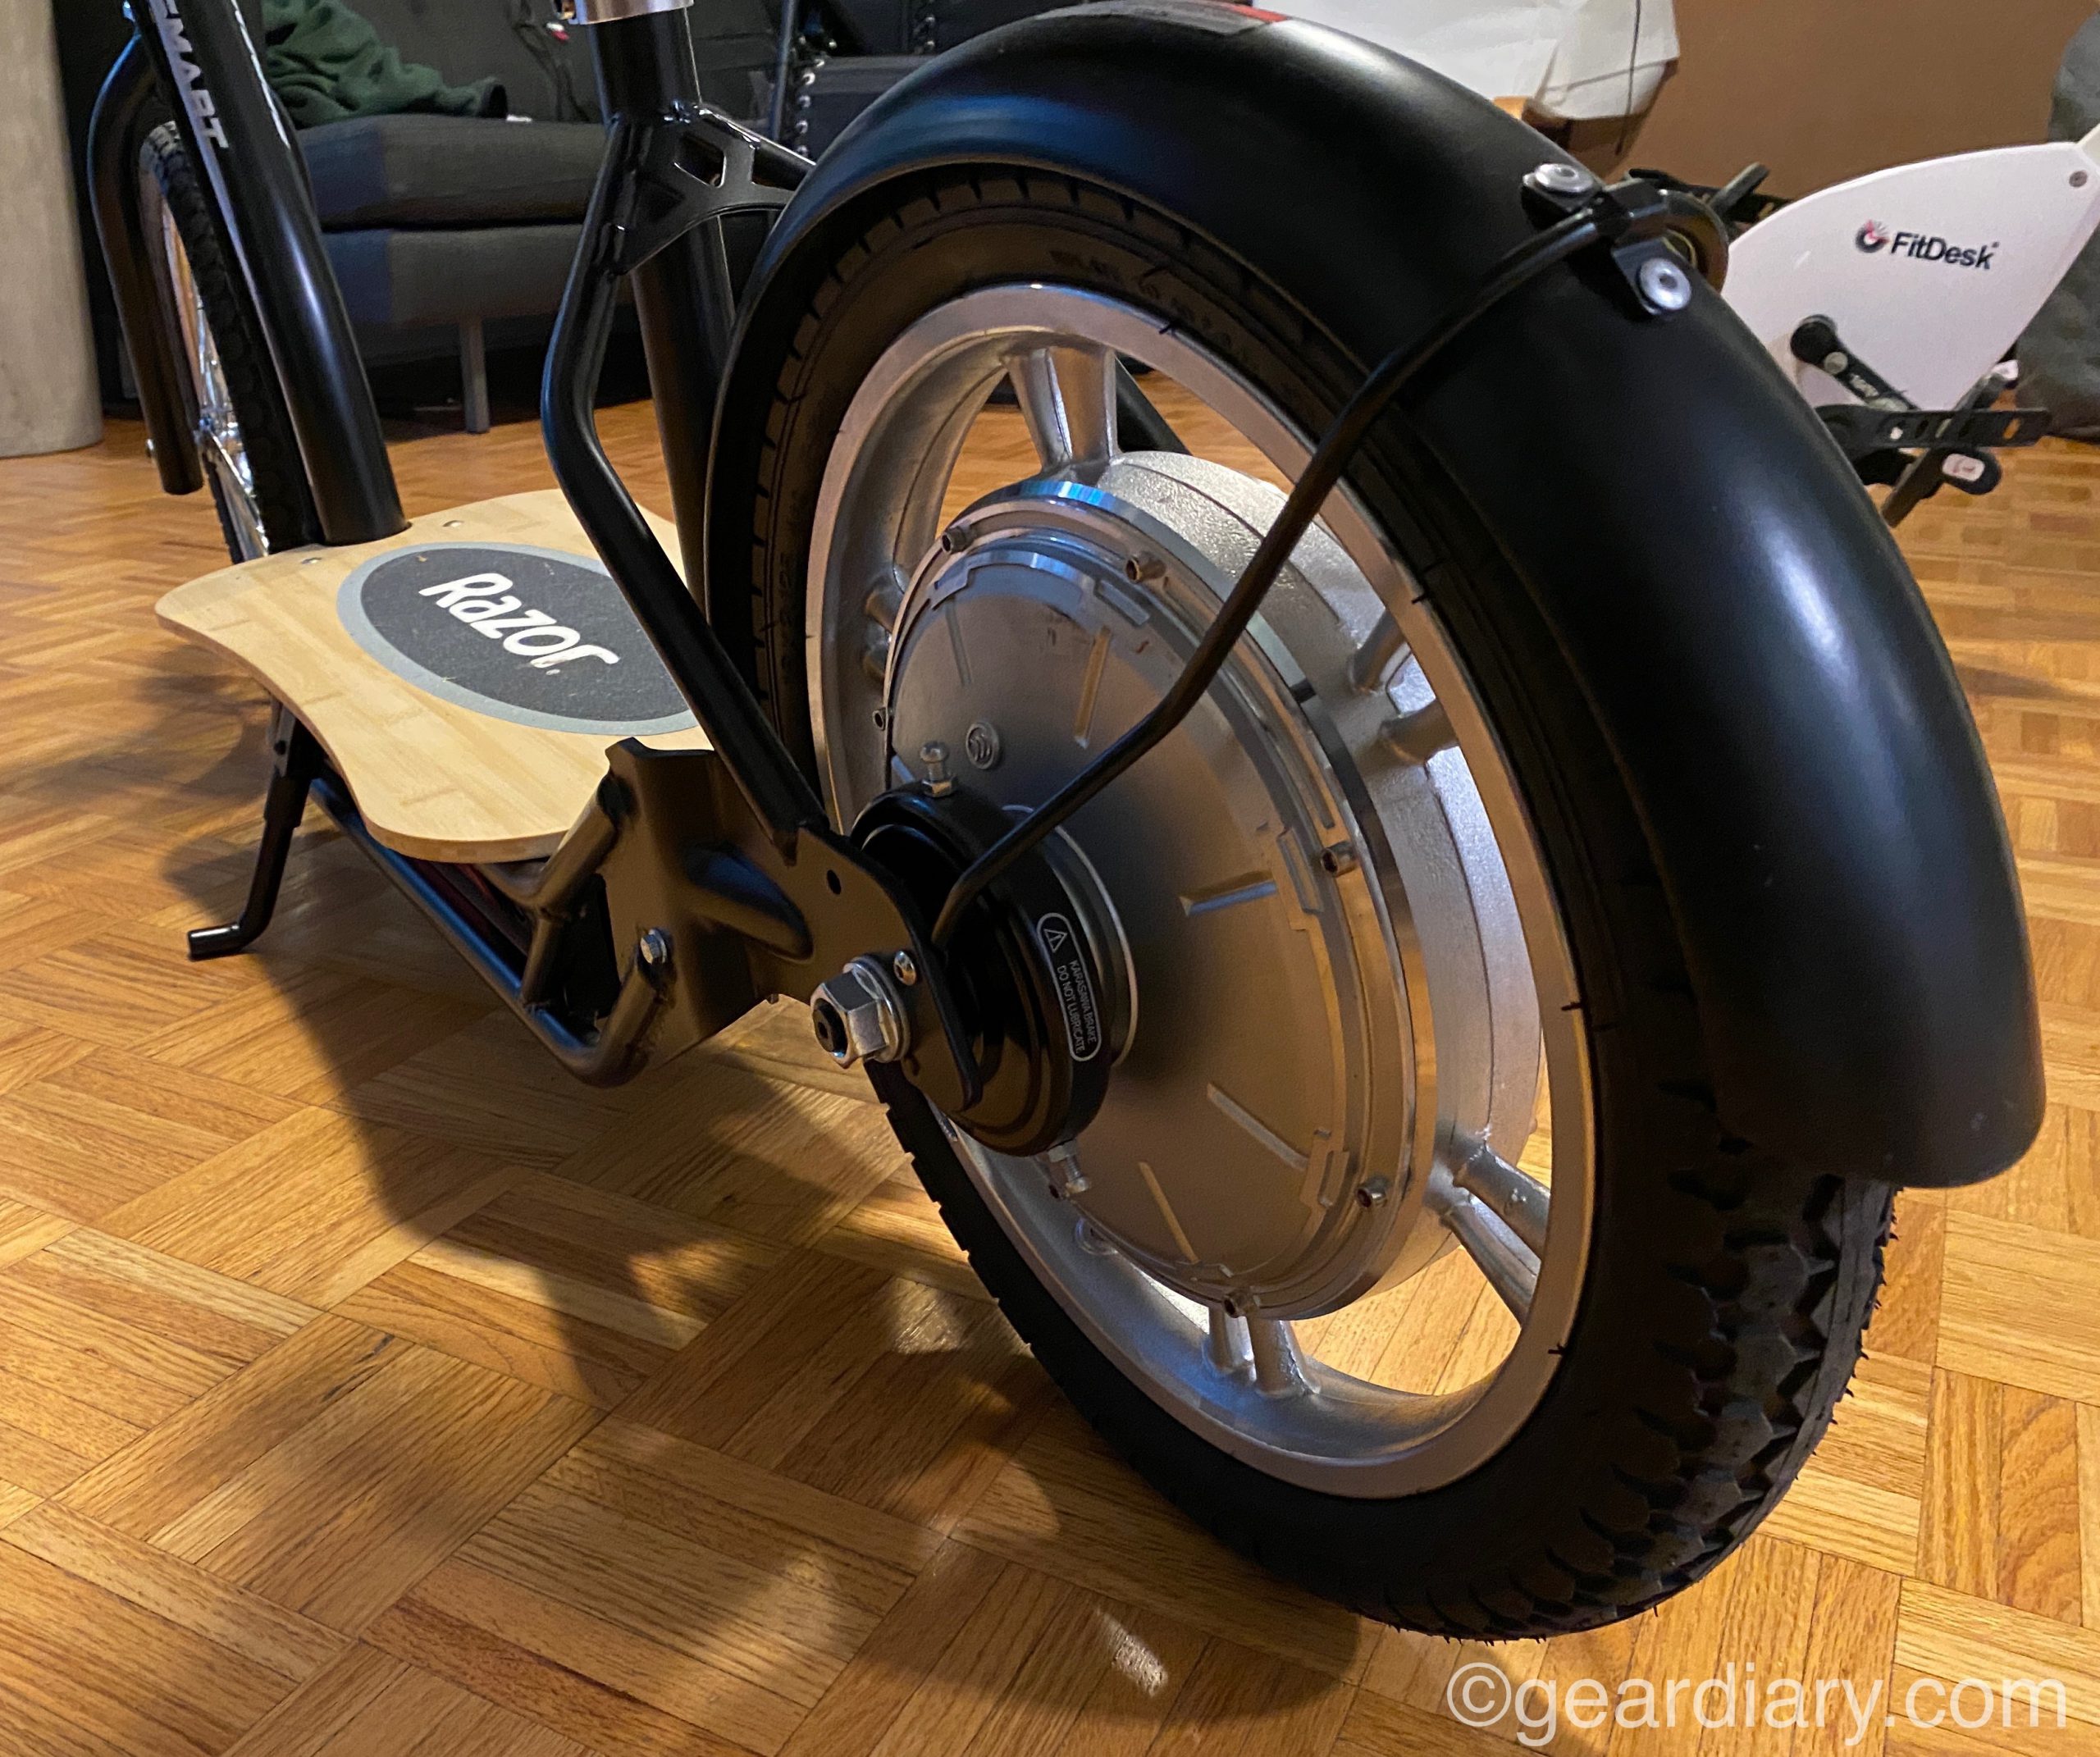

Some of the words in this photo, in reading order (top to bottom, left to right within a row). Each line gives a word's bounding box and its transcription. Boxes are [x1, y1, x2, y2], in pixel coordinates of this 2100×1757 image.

[1890, 230, 1995, 270] FitDesk
[418, 572, 620, 669] Razor
[1057, 965, 1069, 981] DO
[1062, 981, 1076, 1002] NOT
[1067, 1002, 1085, 1053] LUBRICATE
[1084, 1011, 1097, 1044] BRAKE
